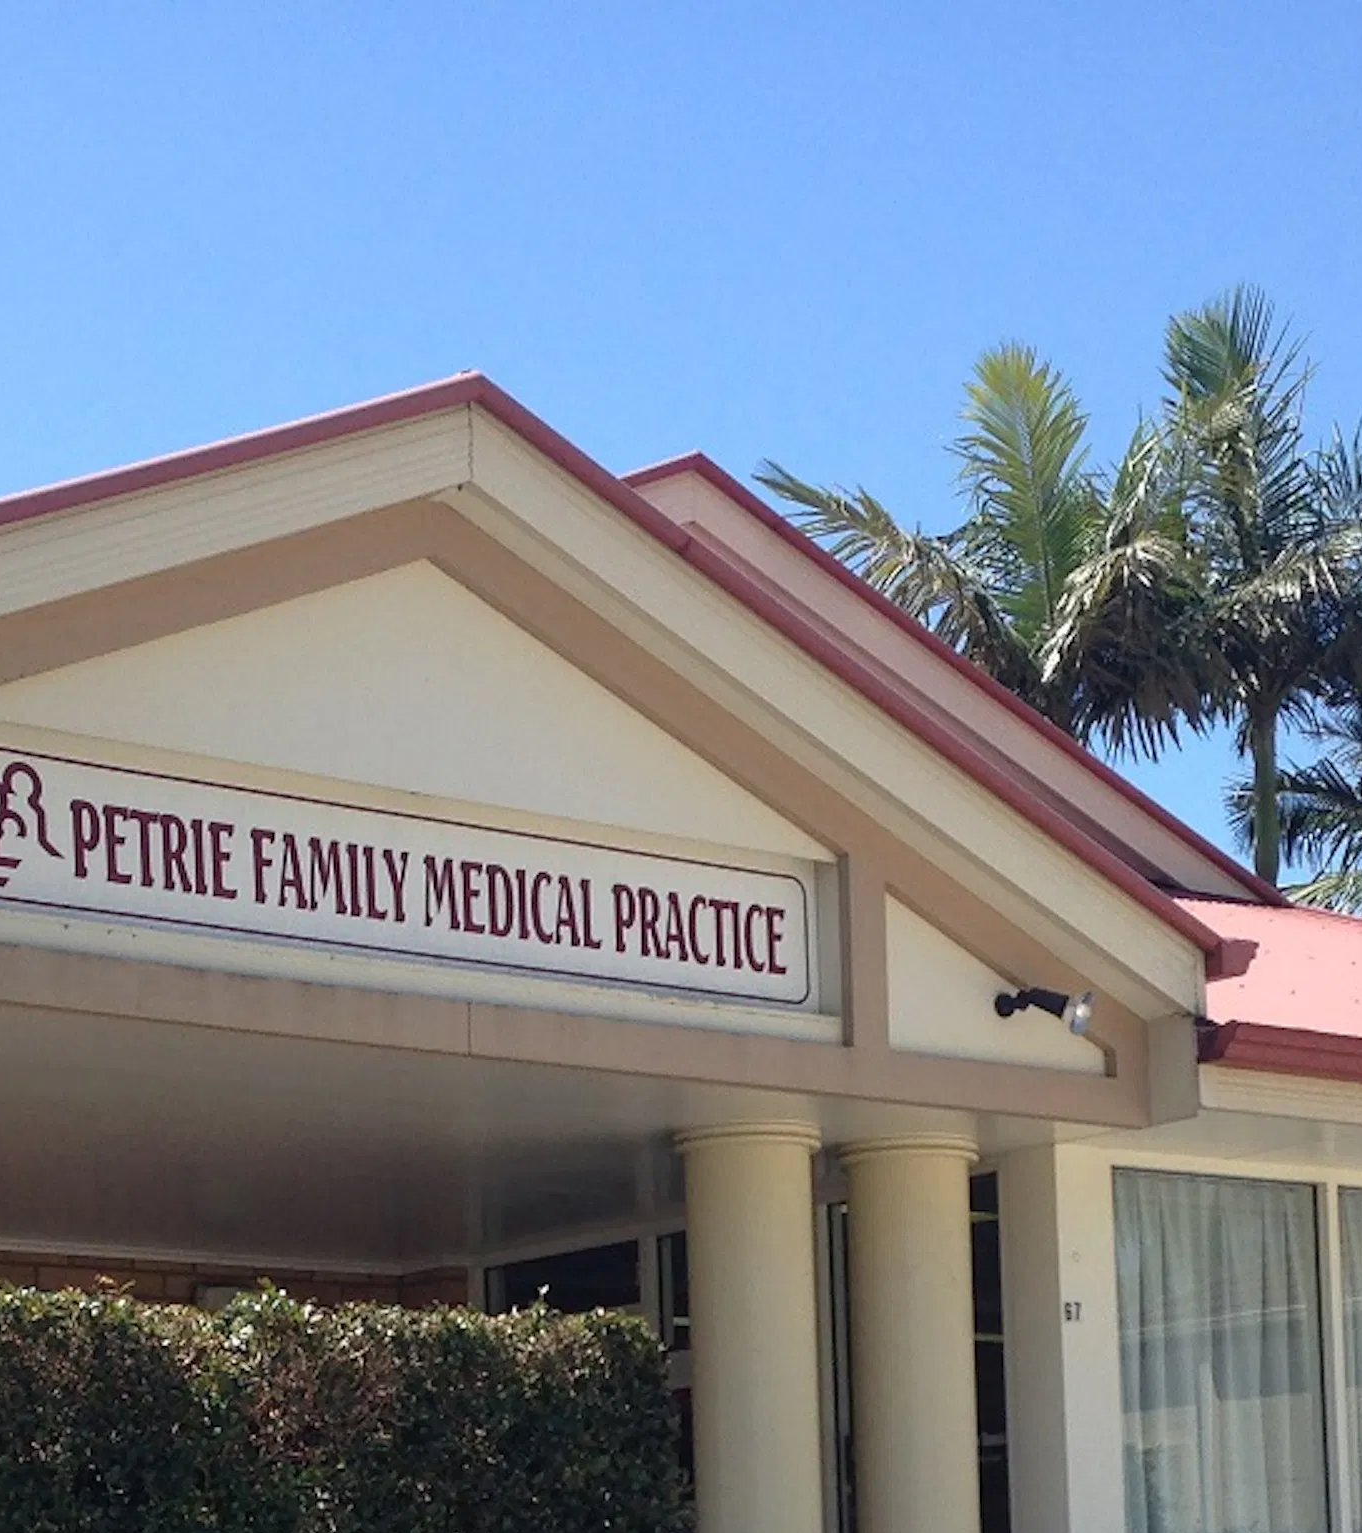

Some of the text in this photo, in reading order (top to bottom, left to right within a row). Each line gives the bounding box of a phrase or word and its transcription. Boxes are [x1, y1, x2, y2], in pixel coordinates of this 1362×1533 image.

[69, 799, 788, 976] PETRIE FAMILY MEDICAL PRACTICE
